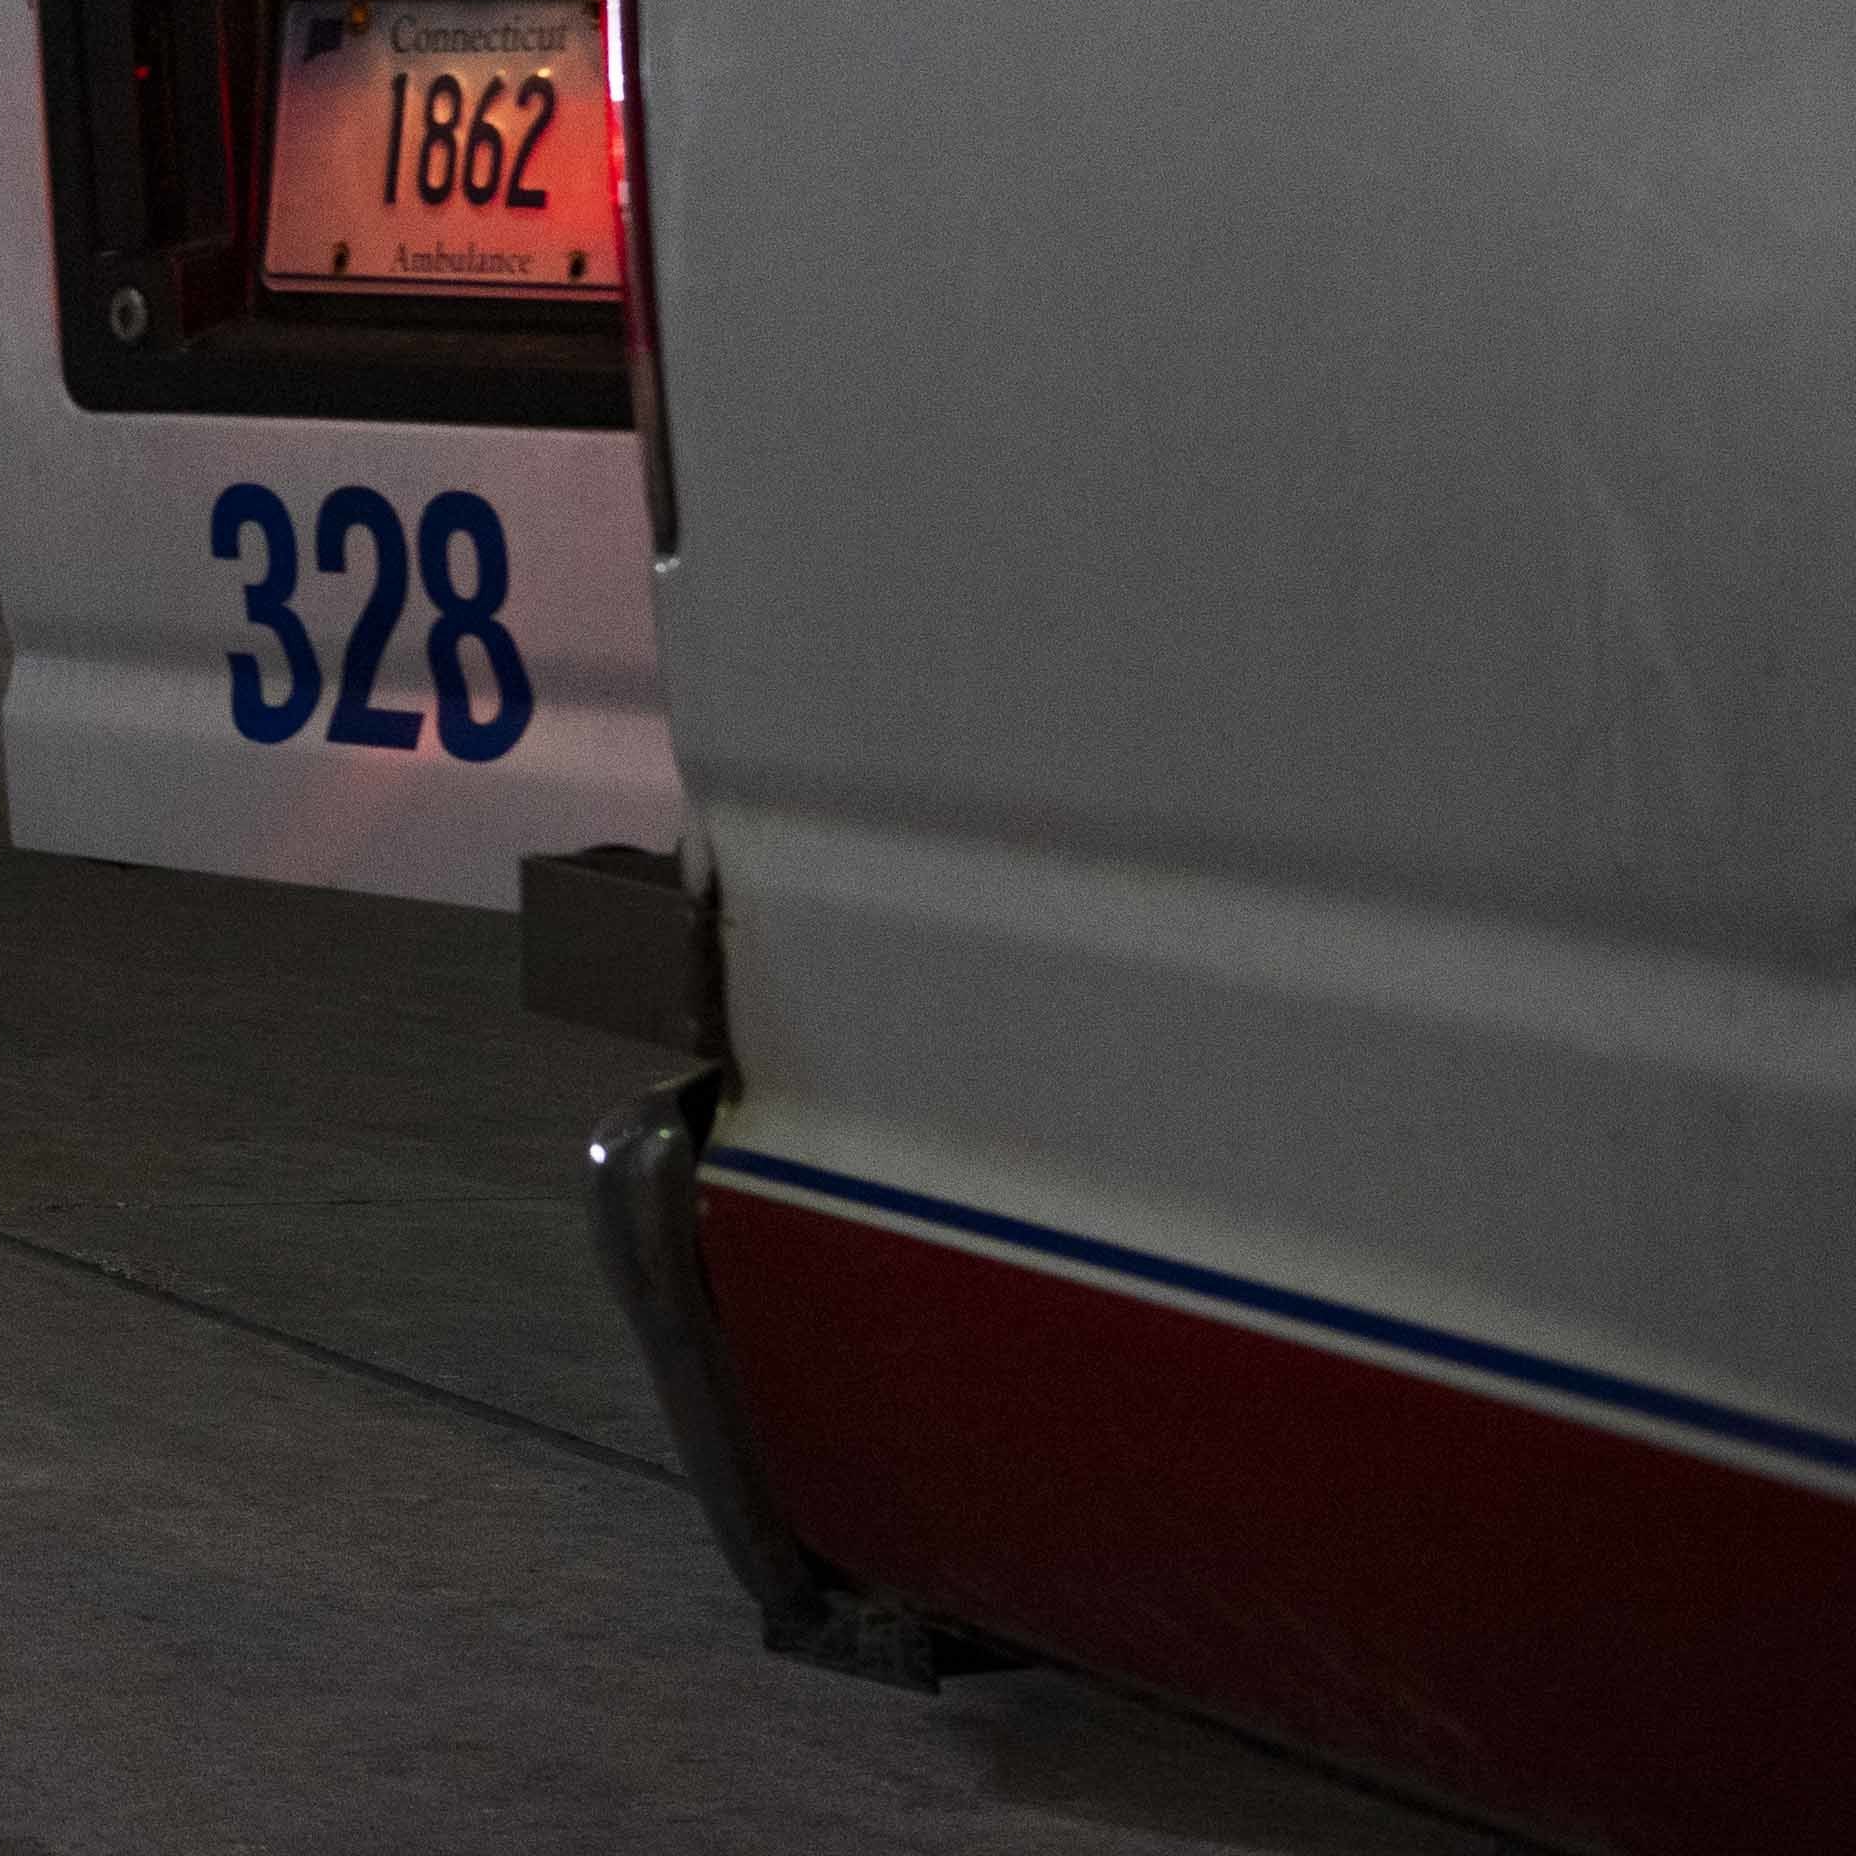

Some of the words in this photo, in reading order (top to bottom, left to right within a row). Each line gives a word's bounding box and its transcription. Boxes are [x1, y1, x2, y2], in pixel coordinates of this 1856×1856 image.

[390, 14, 568, 54] Connecticut
[384, 72, 556, 210] 1862
[389, 242, 535, 276] Ambulance
[210, 481, 535, 764] 328
